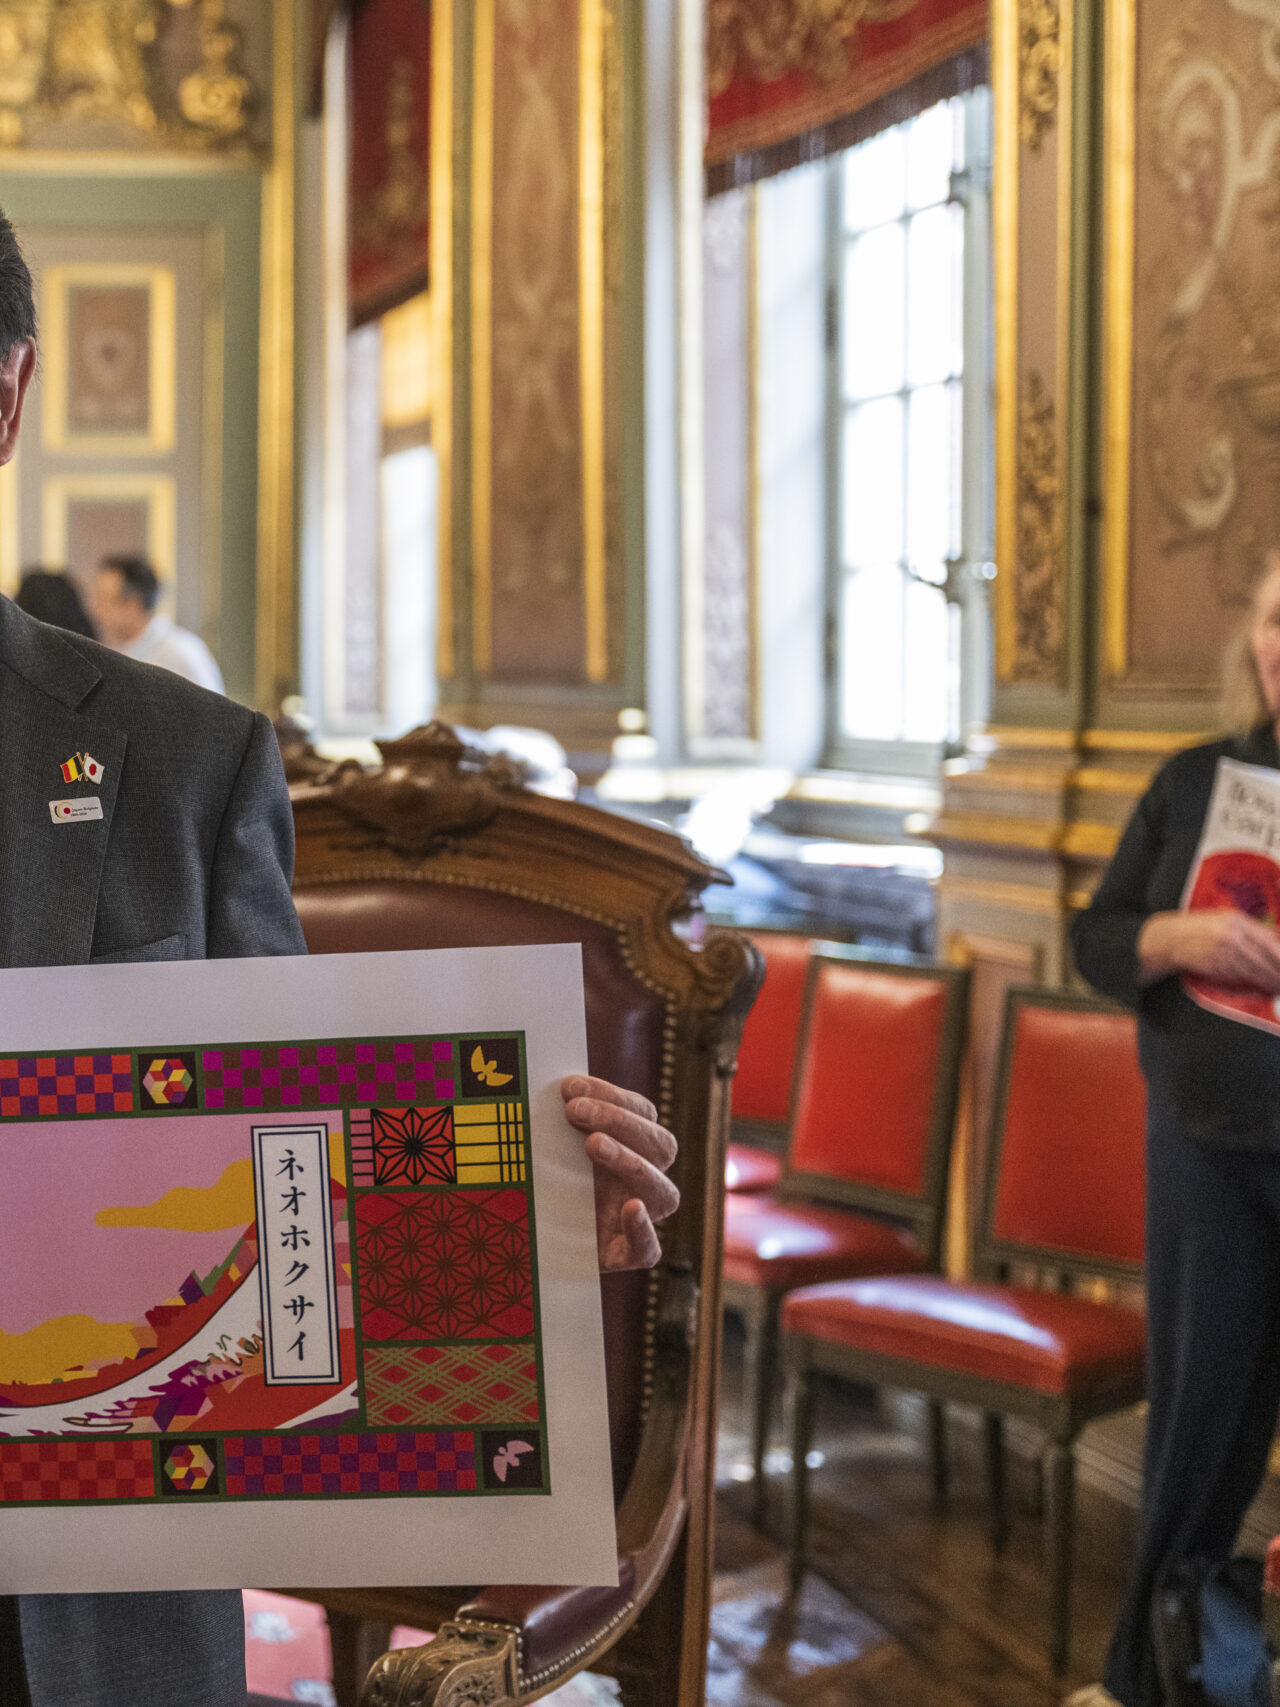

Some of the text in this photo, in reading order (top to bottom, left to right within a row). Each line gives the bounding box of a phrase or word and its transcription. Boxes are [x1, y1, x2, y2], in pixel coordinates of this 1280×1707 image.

[275, 1149, 315, 1361] ネオホクサイ
